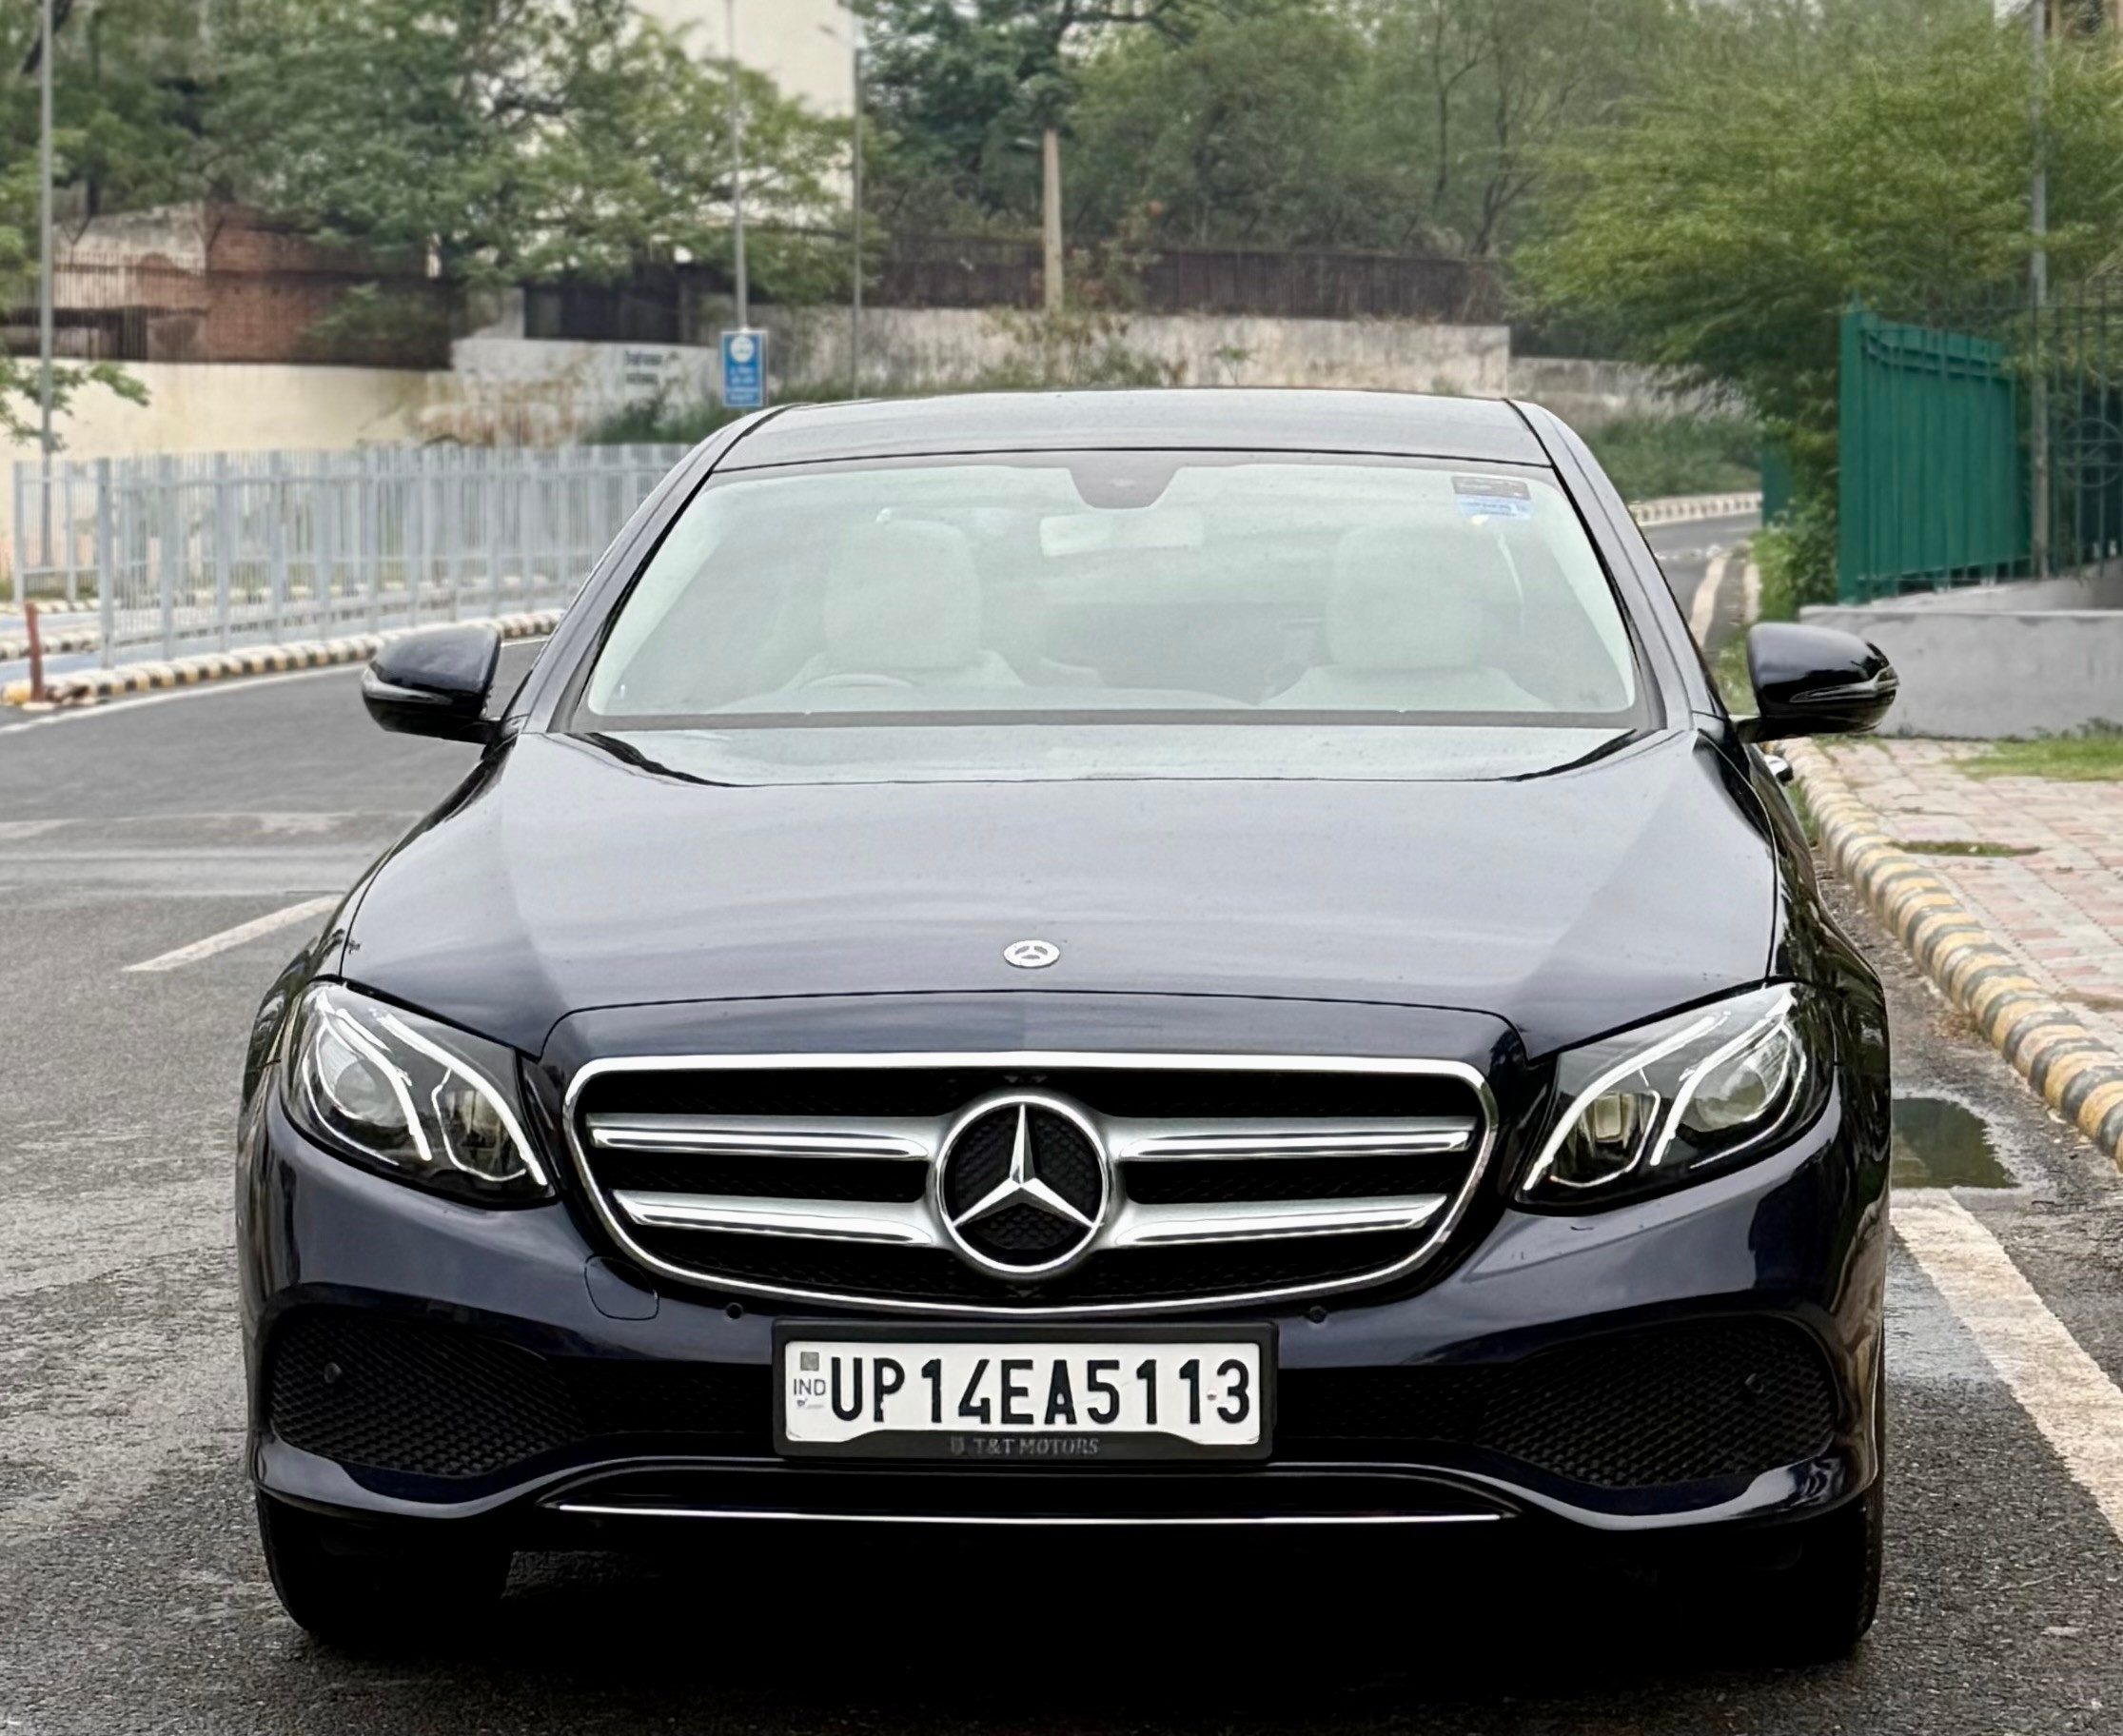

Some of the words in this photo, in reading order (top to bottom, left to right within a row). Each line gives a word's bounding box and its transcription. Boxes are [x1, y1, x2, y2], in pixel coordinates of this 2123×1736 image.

[794, 1378, 827, 1396] IND
[831, 1356, 1250, 1425] UP14EA5113
[973, 1438, 1015, 1455] T&T
[1019, 1438, 1100, 1455] MOTORS
